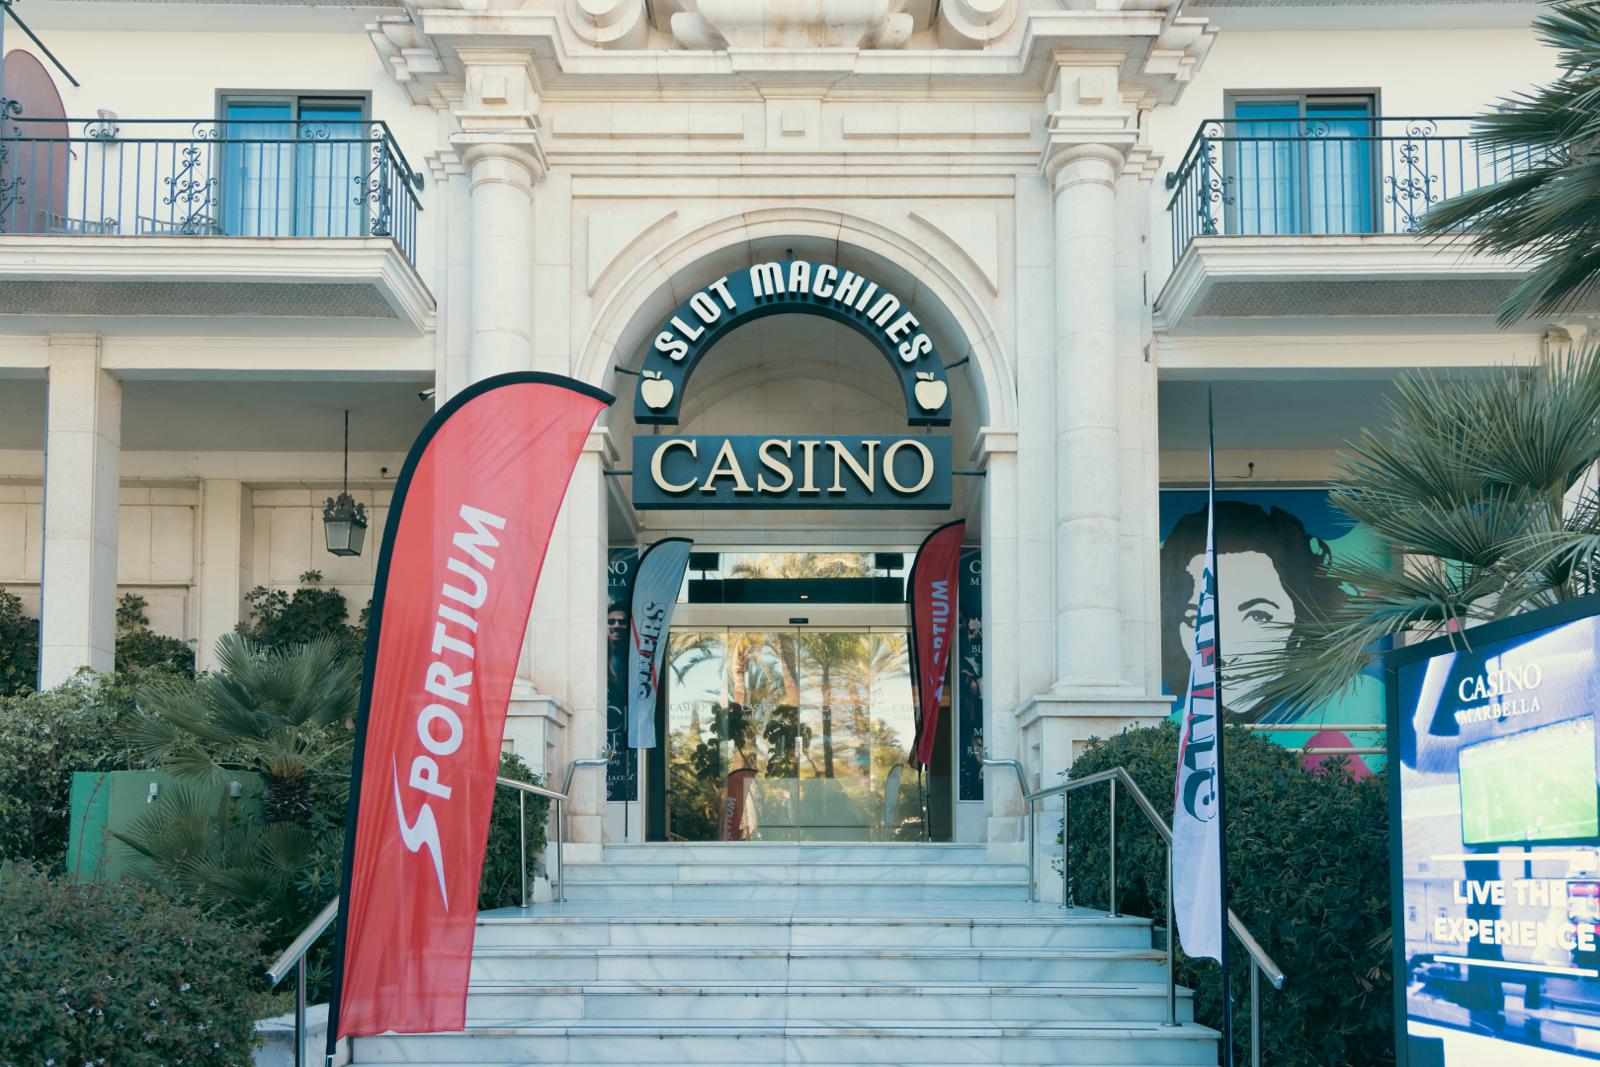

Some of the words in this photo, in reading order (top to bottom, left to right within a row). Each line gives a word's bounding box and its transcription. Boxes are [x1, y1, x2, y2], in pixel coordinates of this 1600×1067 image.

[654, 277, 736, 361] SLOT
[750, 260, 932, 363] MACHINES
[651, 439, 935, 494] CASINO
[1458, 663, 1541, 702] CASINO
[393, 504, 506, 913] SPORTIUM
[1456, 697, 1540, 724] MARBELLA
[1453, 880, 1505, 906] LIVE
[1512, 880, 1567, 907] THE
[1434, 917, 1597, 952] EXPERIENCE
